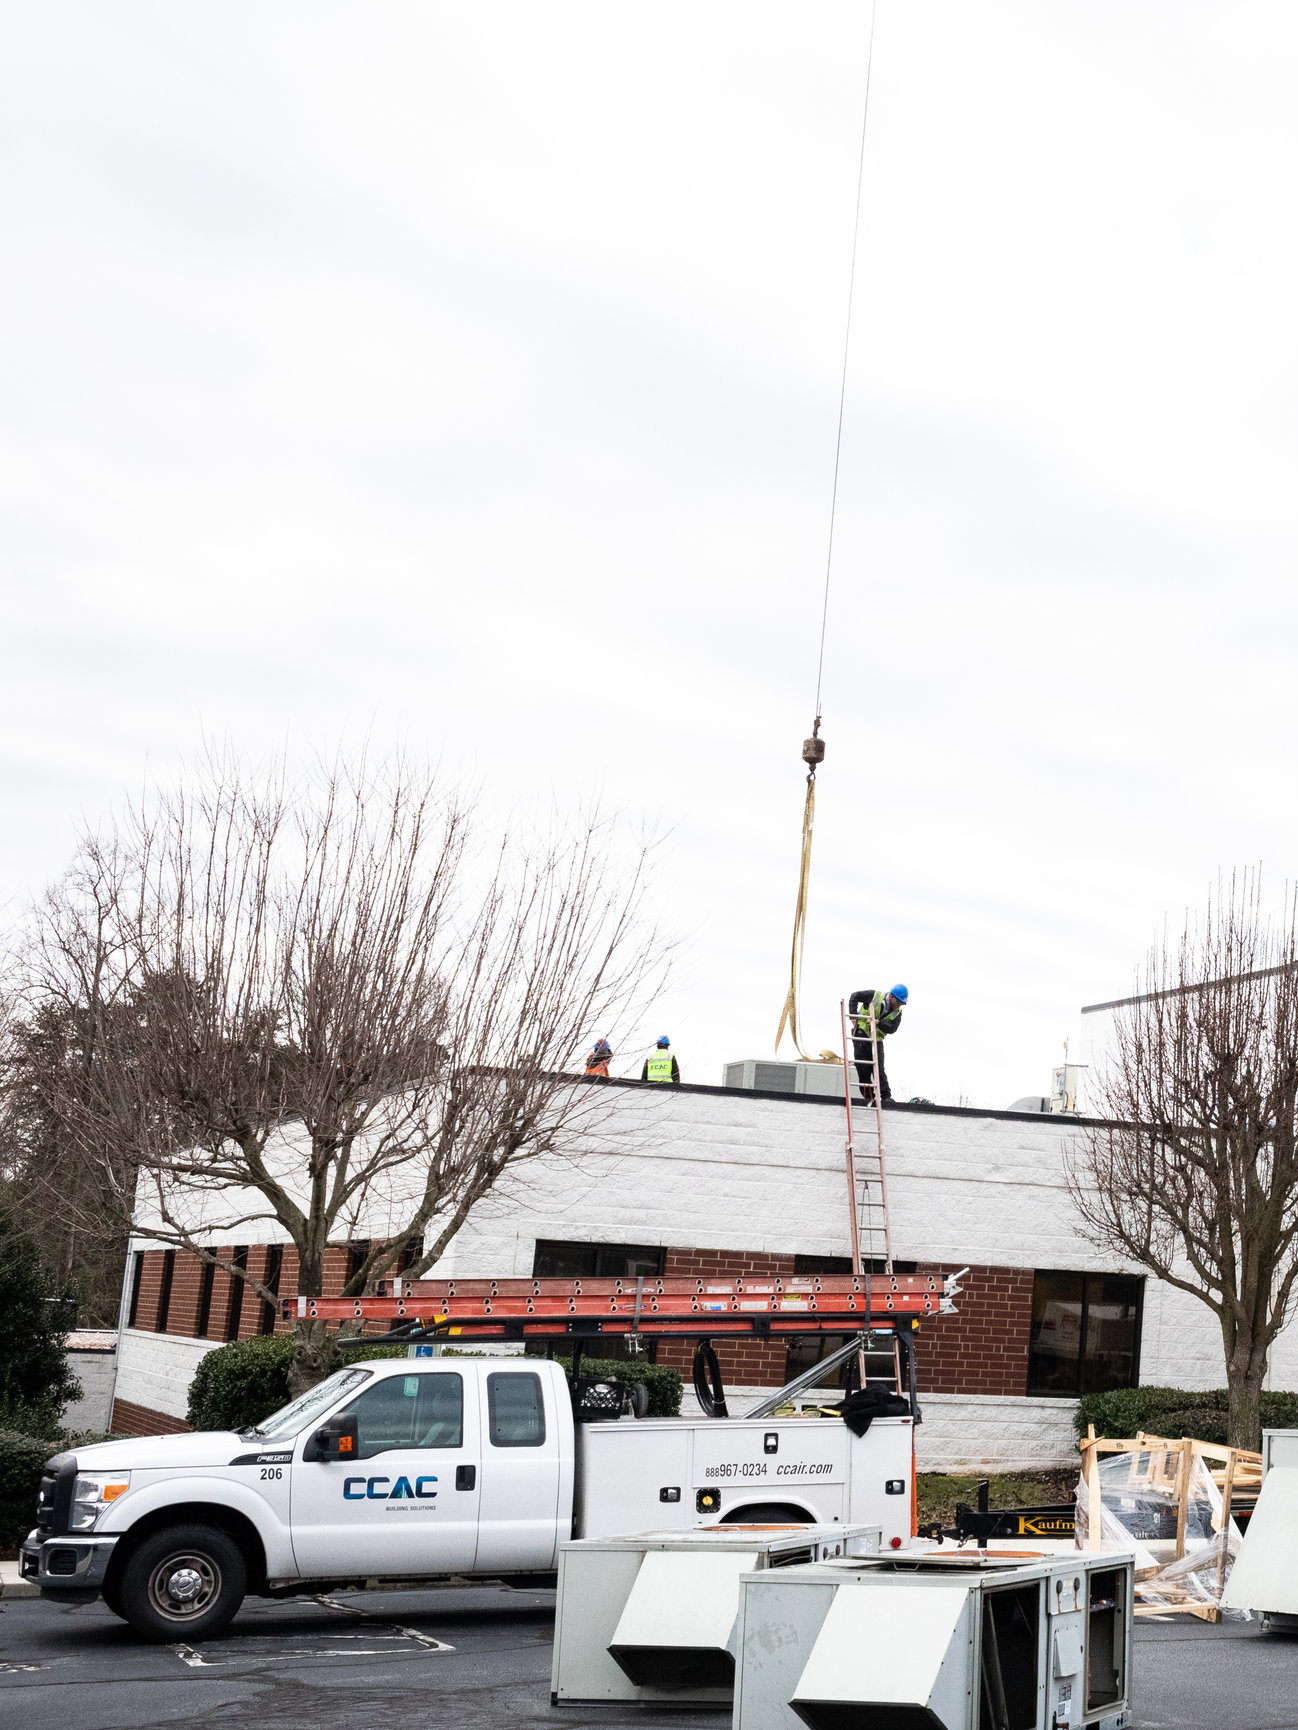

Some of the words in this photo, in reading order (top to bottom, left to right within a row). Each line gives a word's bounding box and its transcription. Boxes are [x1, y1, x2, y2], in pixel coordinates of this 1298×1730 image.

[260, 1468, 283, 1480] 206
[776, 1461, 833, 1475] ccair.com
[343, 1476, 438, 1500] CCAC
